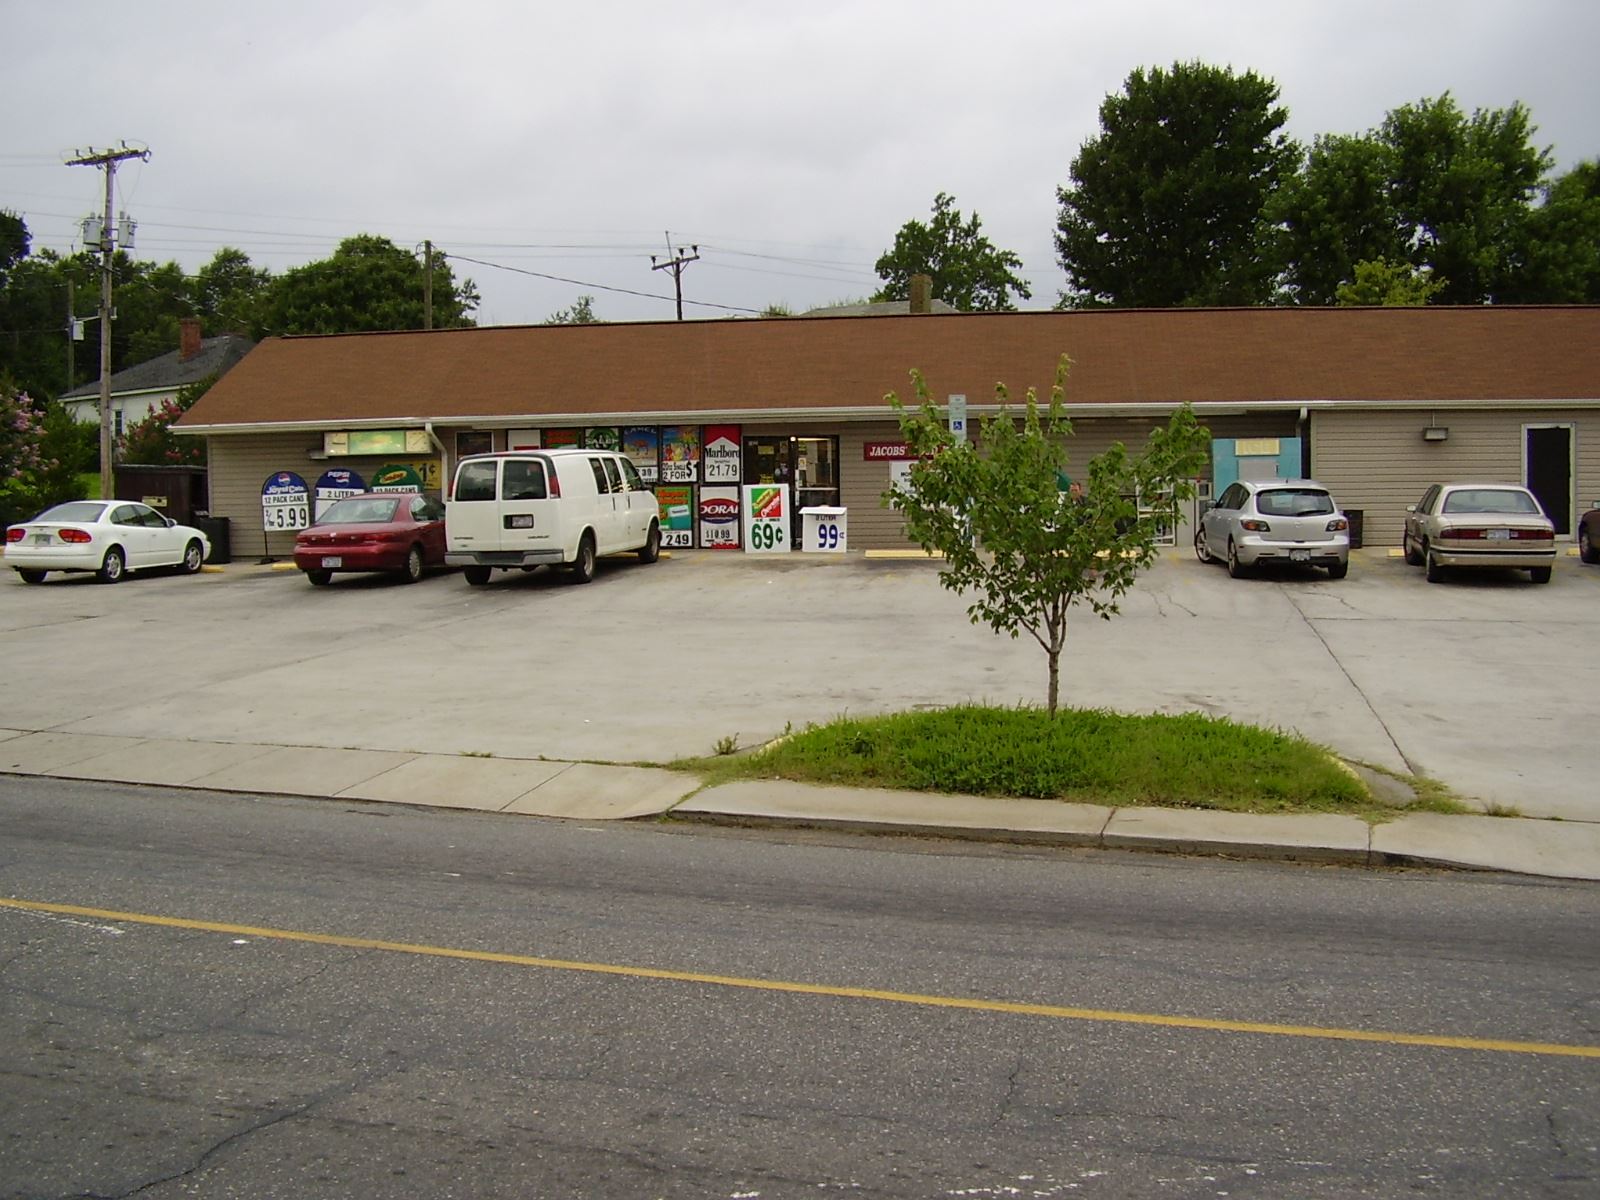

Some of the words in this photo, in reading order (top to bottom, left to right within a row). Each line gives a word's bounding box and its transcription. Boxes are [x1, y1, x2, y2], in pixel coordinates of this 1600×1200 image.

[585, 435, 619, 446] SALEM
[670, 471, 686, 480] FOR
[289, 495, 304, 503] CANS
[276, 508, 307, 528] 5.99
